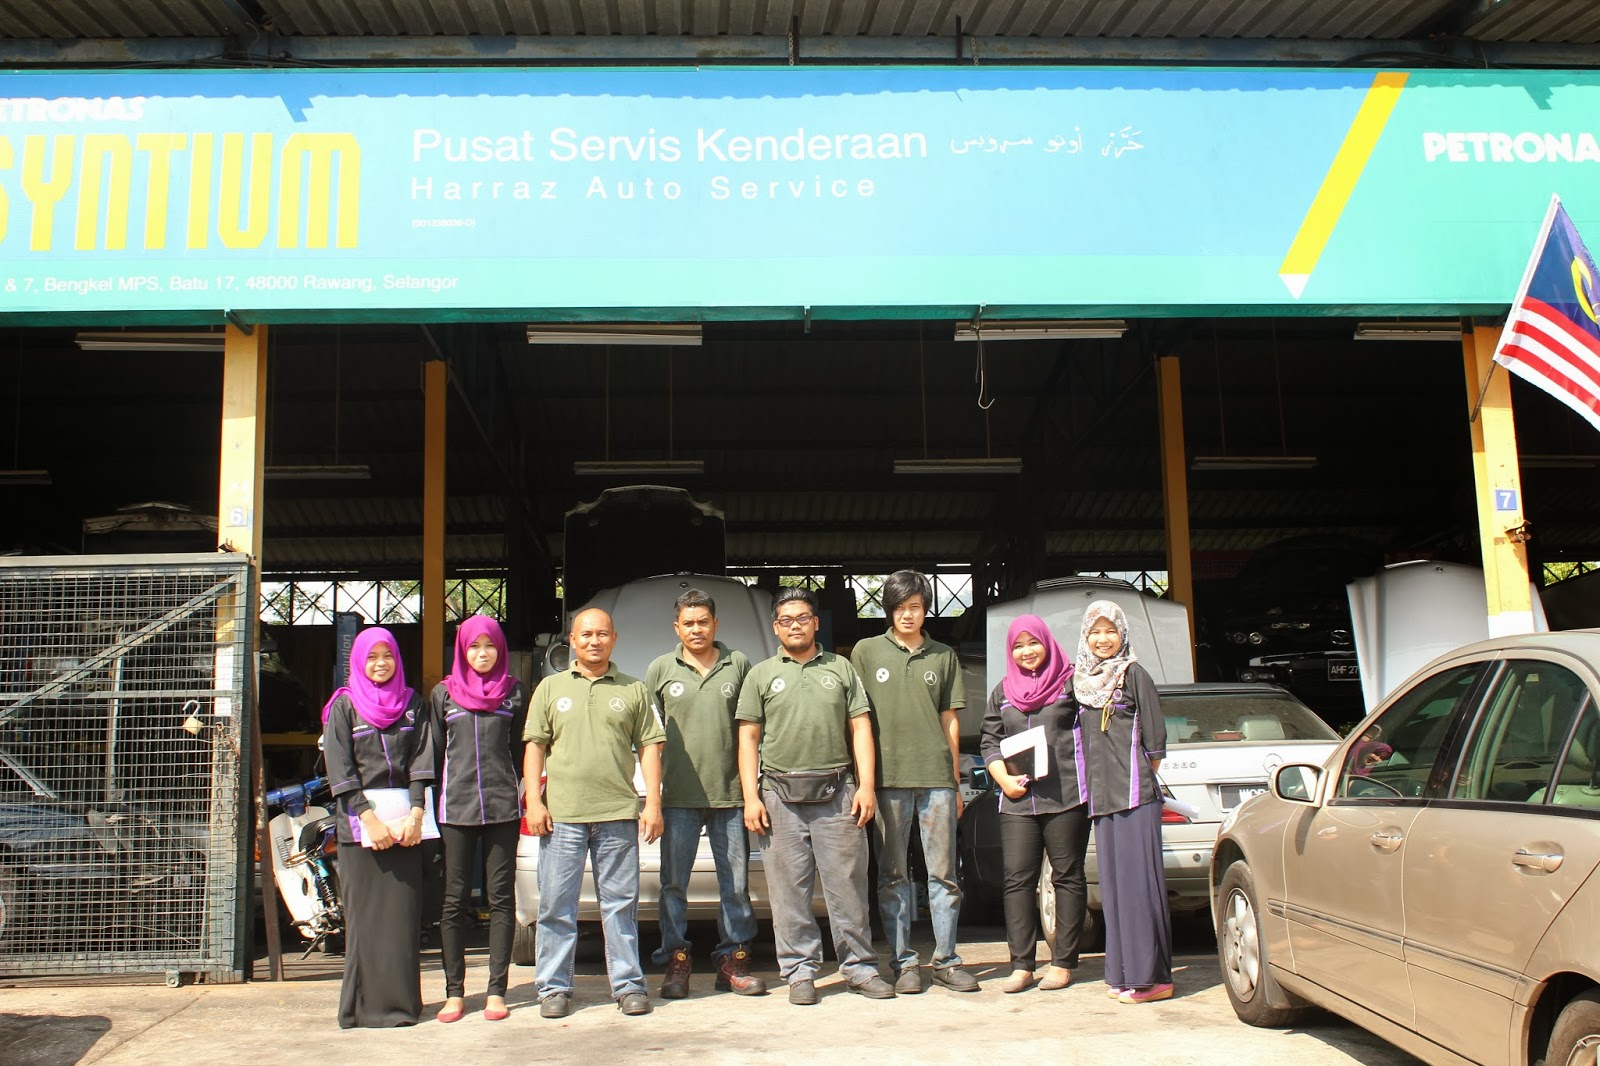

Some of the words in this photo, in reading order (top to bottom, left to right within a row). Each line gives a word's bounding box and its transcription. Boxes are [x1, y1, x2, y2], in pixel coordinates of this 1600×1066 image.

[412, 128, 535, 163] Pusat
[549, 127, 682, 163] Servis
[697, 127, 928, 162] Kenderaan
[1422, 131, 1600, 163] PETRONA
[0, 132, 362, 251] YNTIUM
[410, 175, 558, 200] Harraz
[585, 175, 682, 200] Auto
[710, 174, 875, 200] Service
[4, 277, 17, 291] &
[23, 277, 39, 295] 7,
[44, 276, 113, 295] Bengkel
[119, 275, 164, 293] MPS,
[170, 275, 209, 290] Batu
[216, 275, 238, 293] 17,
[245, 274, 299, 290] 48000
[303, 273, 377, 292] Rawang,
[382, 273, 459, 292] Selangor
[1500, 492, 1512, 509] 7
[230, 507, 243, 525] 6
[1330, 665, 1347, 675] AHF
